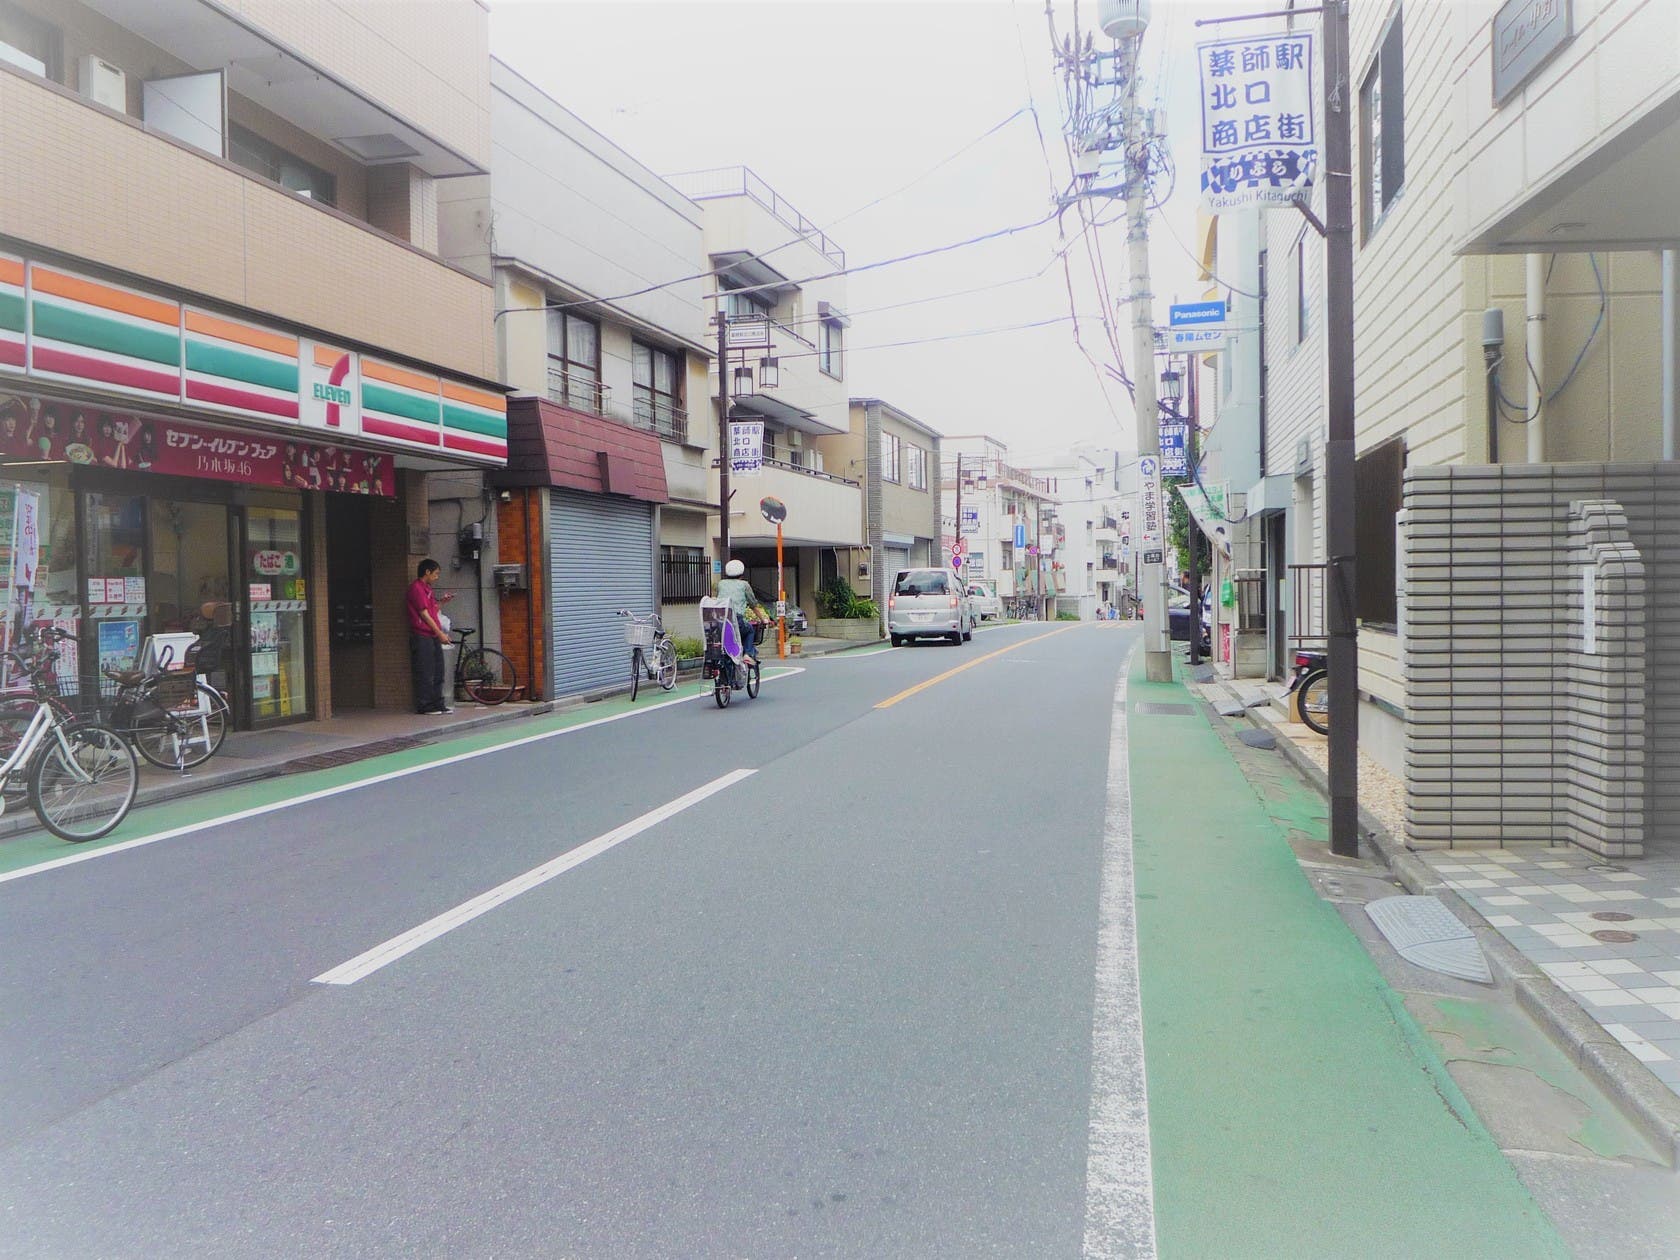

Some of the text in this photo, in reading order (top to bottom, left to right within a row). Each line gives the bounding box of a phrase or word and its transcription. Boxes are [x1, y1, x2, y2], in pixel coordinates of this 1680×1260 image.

[1209, 42, 1304, 77] 薬師駅
[1210, 80, 1271, 111] 北口
[1211, 112, 1305, 148] 商店街
[1208, 189, 1309, 208] Yakushi Kitaguchi
[1173, 307, 1220, 320] Panasonic
[251, 442, 277, 459] フェア
